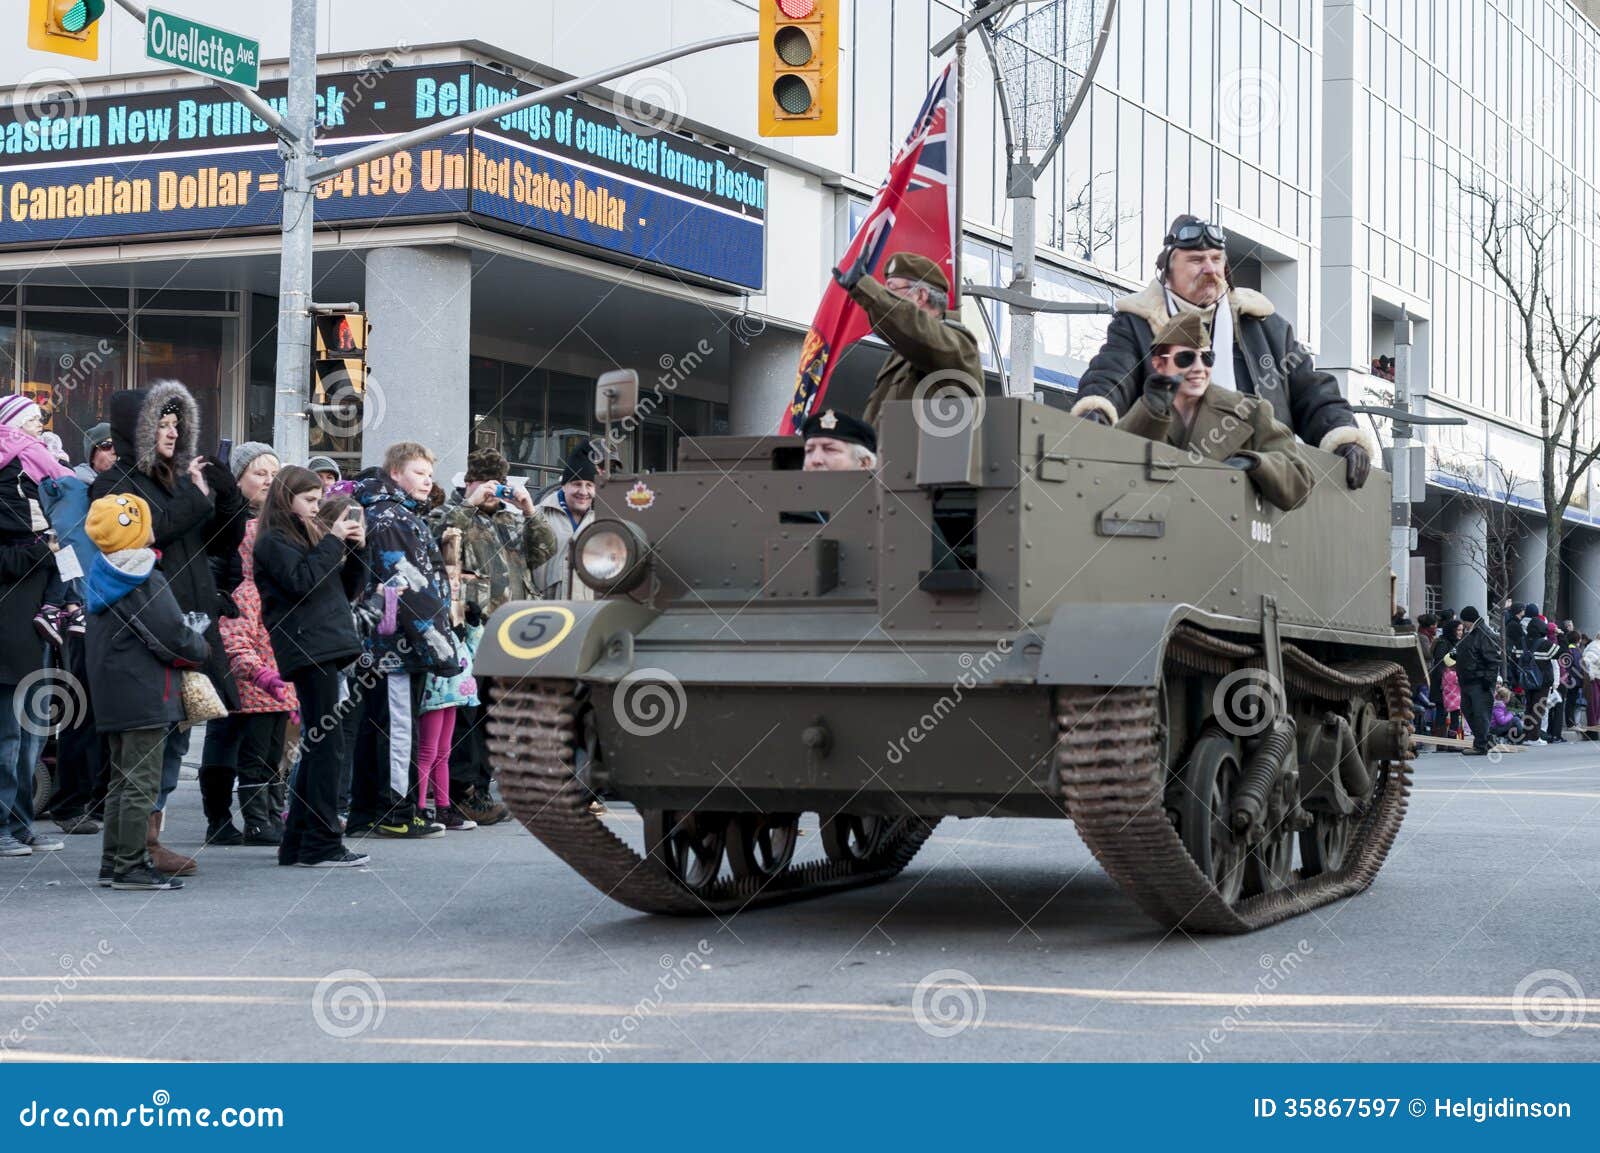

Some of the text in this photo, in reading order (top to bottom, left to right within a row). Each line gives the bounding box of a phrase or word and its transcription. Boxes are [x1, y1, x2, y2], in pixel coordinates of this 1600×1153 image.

[151, 15, 256, 76] Ouellette Ave.
[10, 176, 152, 223] Canadian
[158, 167, 253, 212] Dollar
[421, 146, 511, 200] United
[513, 160, 572, 217] States
[574, 178, 627, 232] Dollar
[108, 105, 173, 146] New
[555, 107, 574, 147] of
[575, 117, 658, 175] convicted
[660, 140, 714, 193] former
[715, 158, 765, 210] Boston
[519, 614, 553, 642] 5
